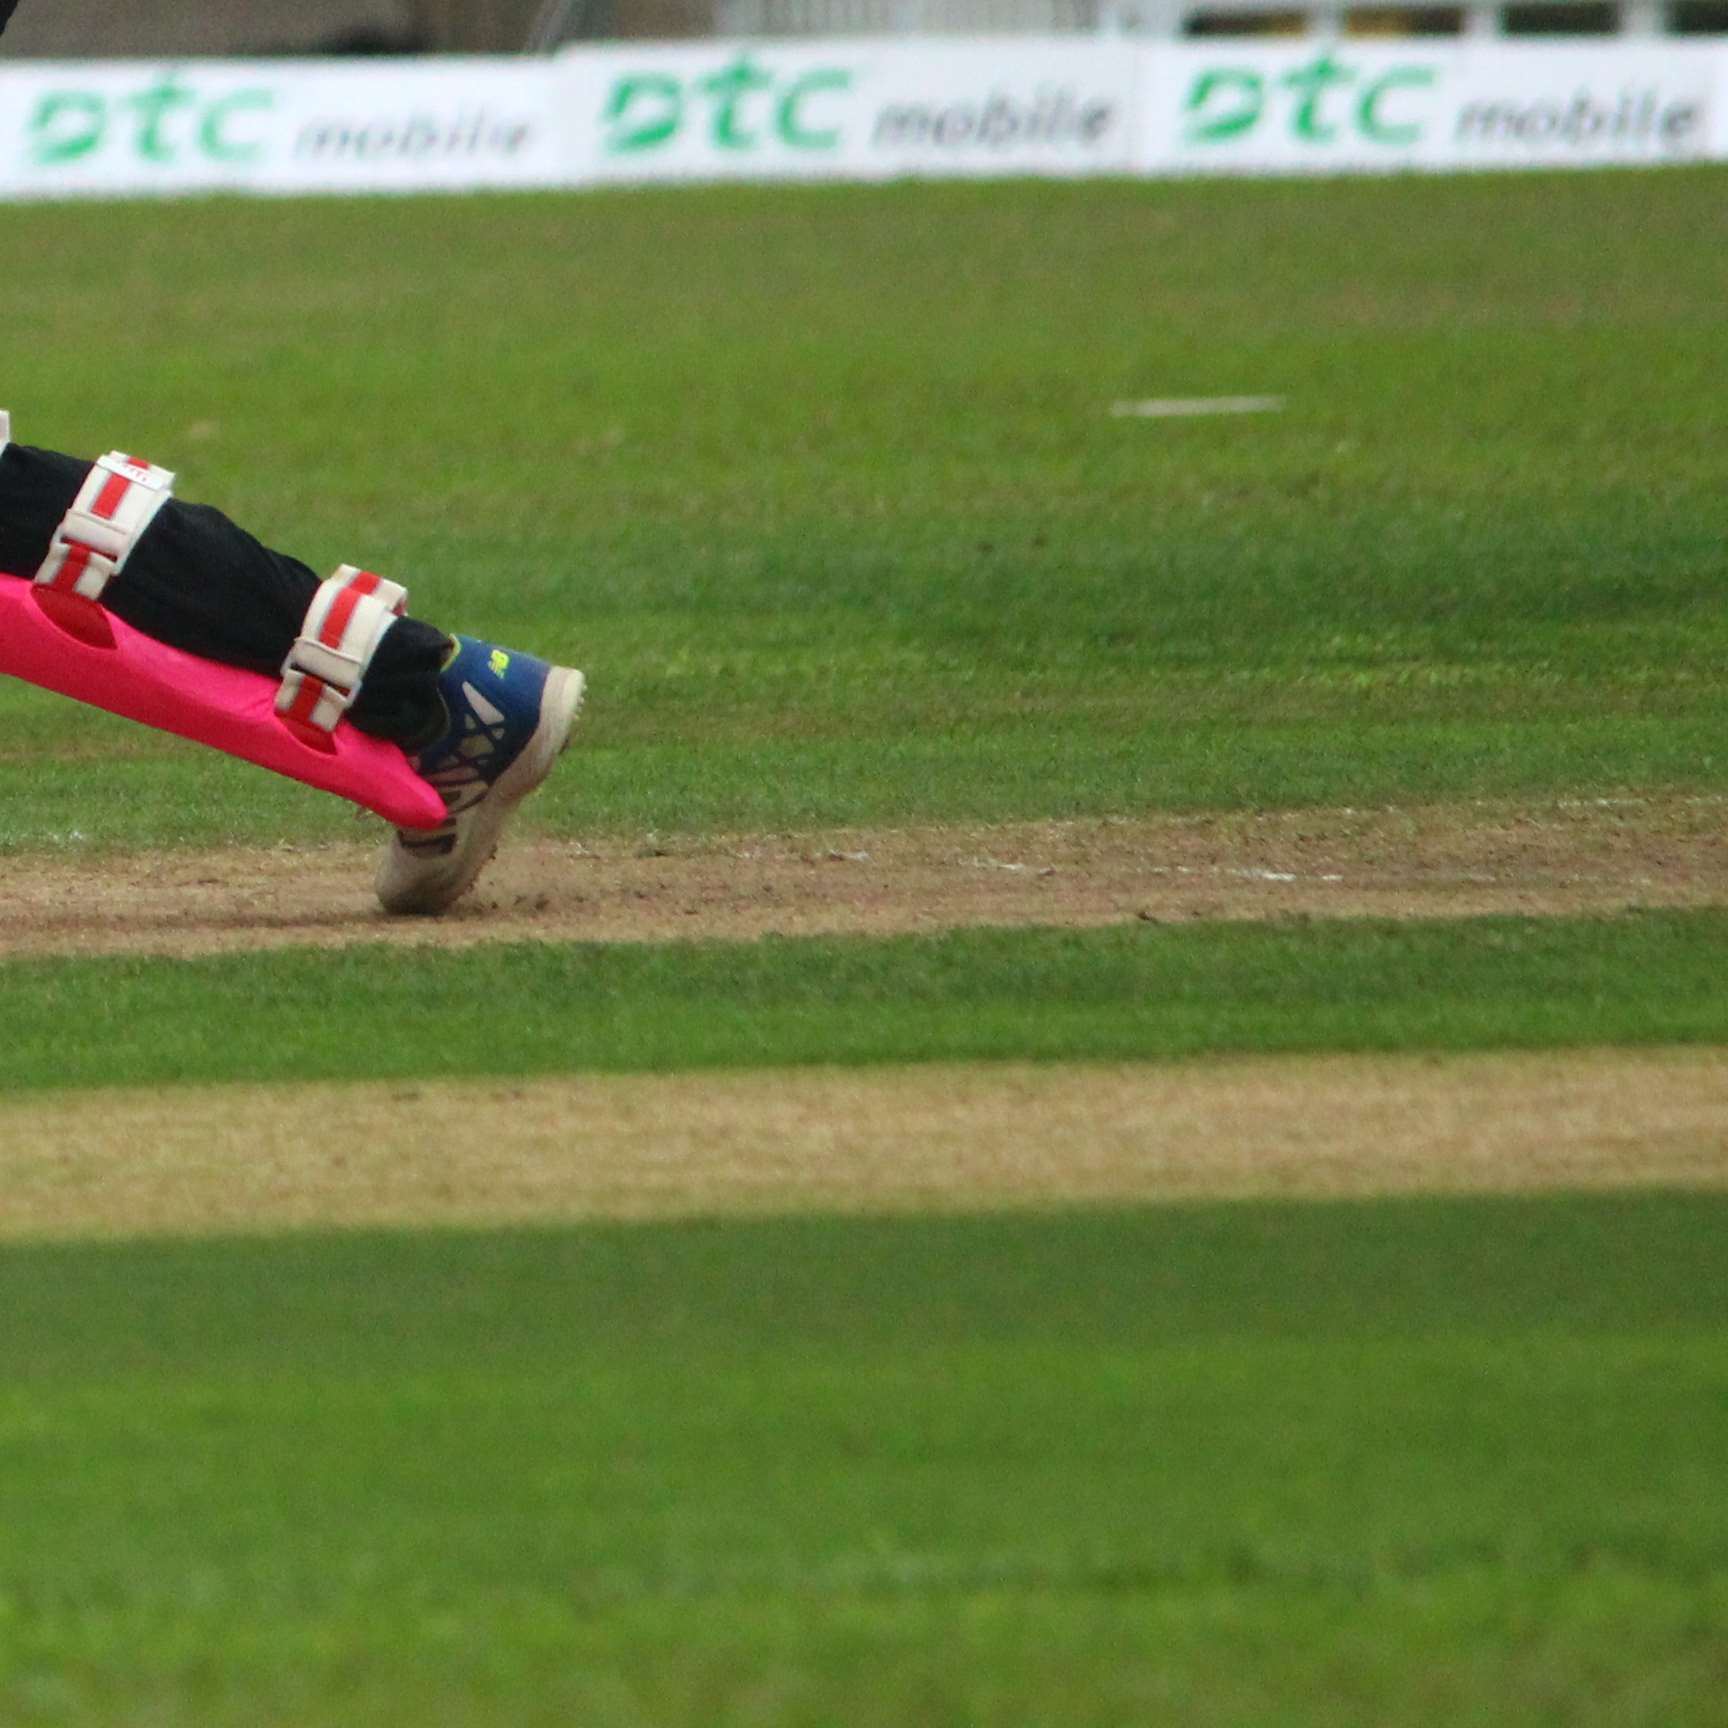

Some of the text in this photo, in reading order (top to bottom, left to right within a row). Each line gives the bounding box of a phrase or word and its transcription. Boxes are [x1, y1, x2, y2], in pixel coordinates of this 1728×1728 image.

[294, 102, 532, 162] mobile
[872, 86, 1117, 152] mobile
[1452, 84, 1697, 146] mobile
